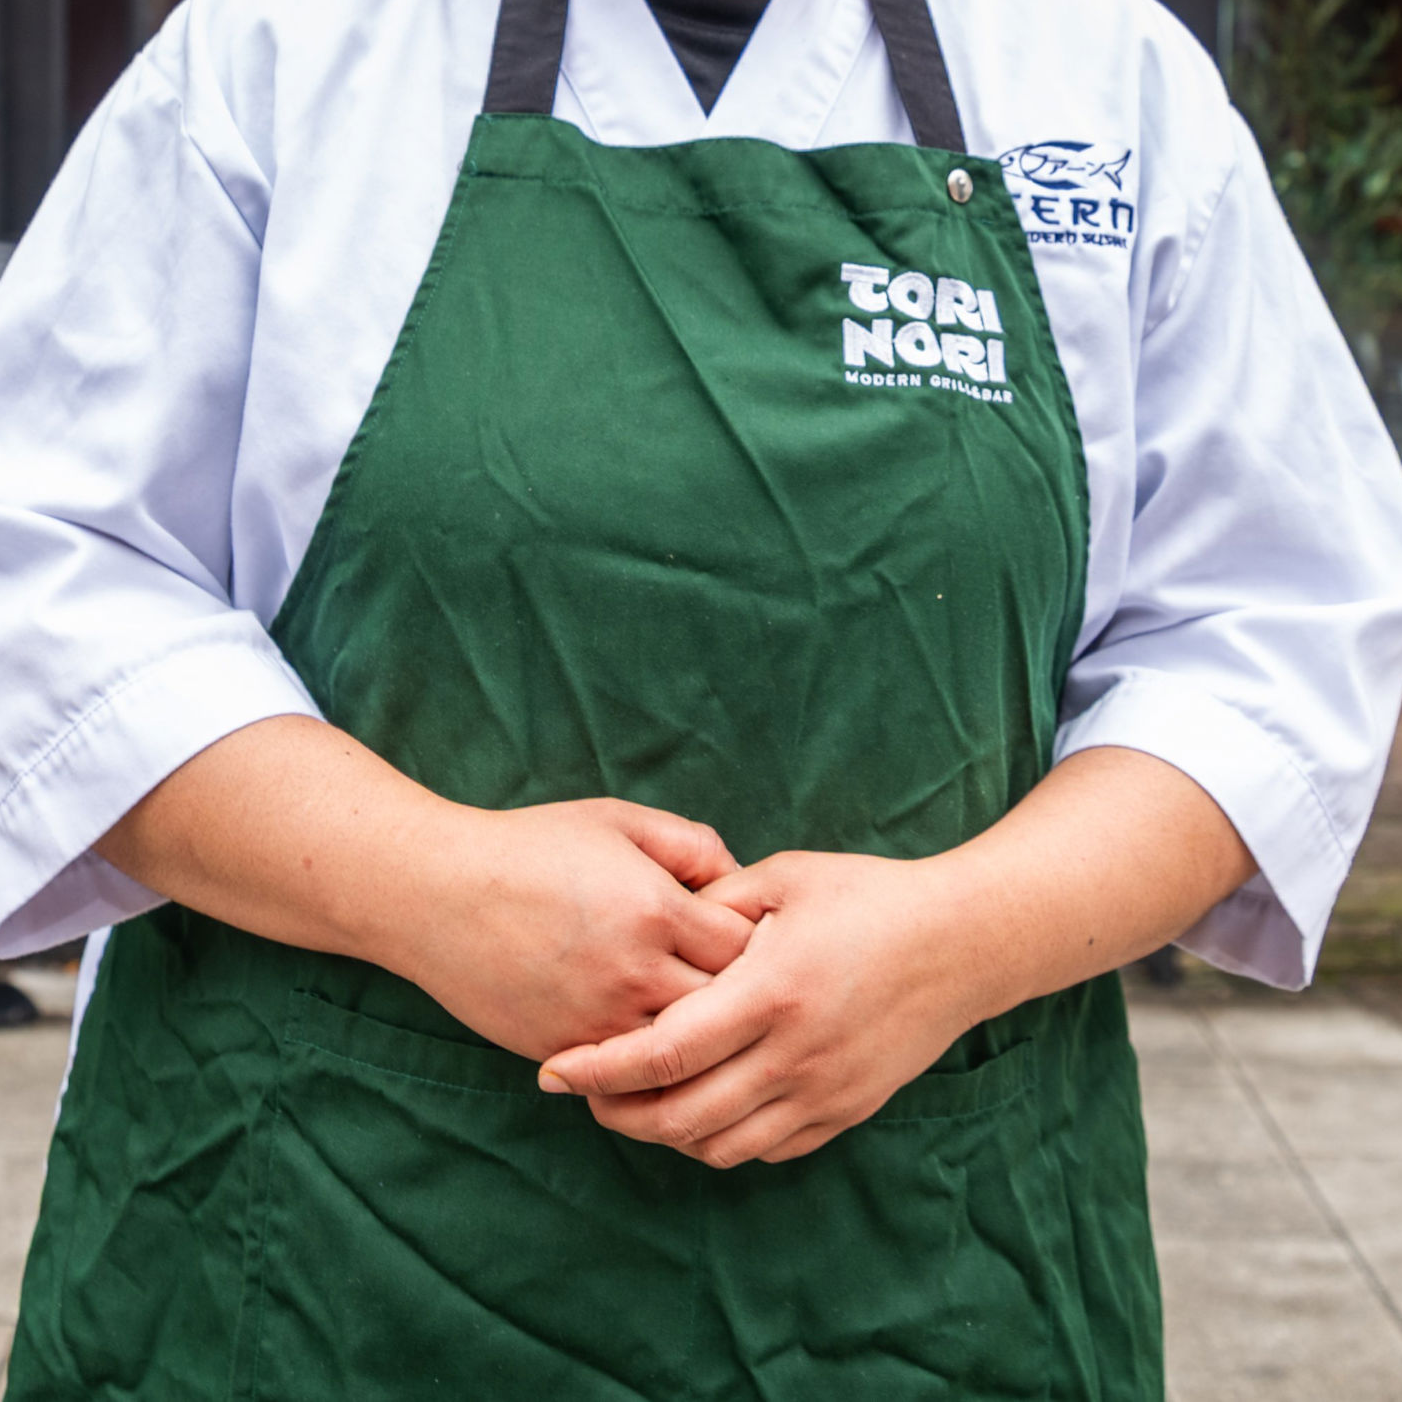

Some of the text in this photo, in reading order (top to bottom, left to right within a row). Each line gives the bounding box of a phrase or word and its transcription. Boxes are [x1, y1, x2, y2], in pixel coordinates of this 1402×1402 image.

[1011, 193, 1135, 234] ERN
[840, 262, 1005, 334] TORI
[842, 317, 1007, 384] NORI
[844, 370, 922, 387] MODERN
